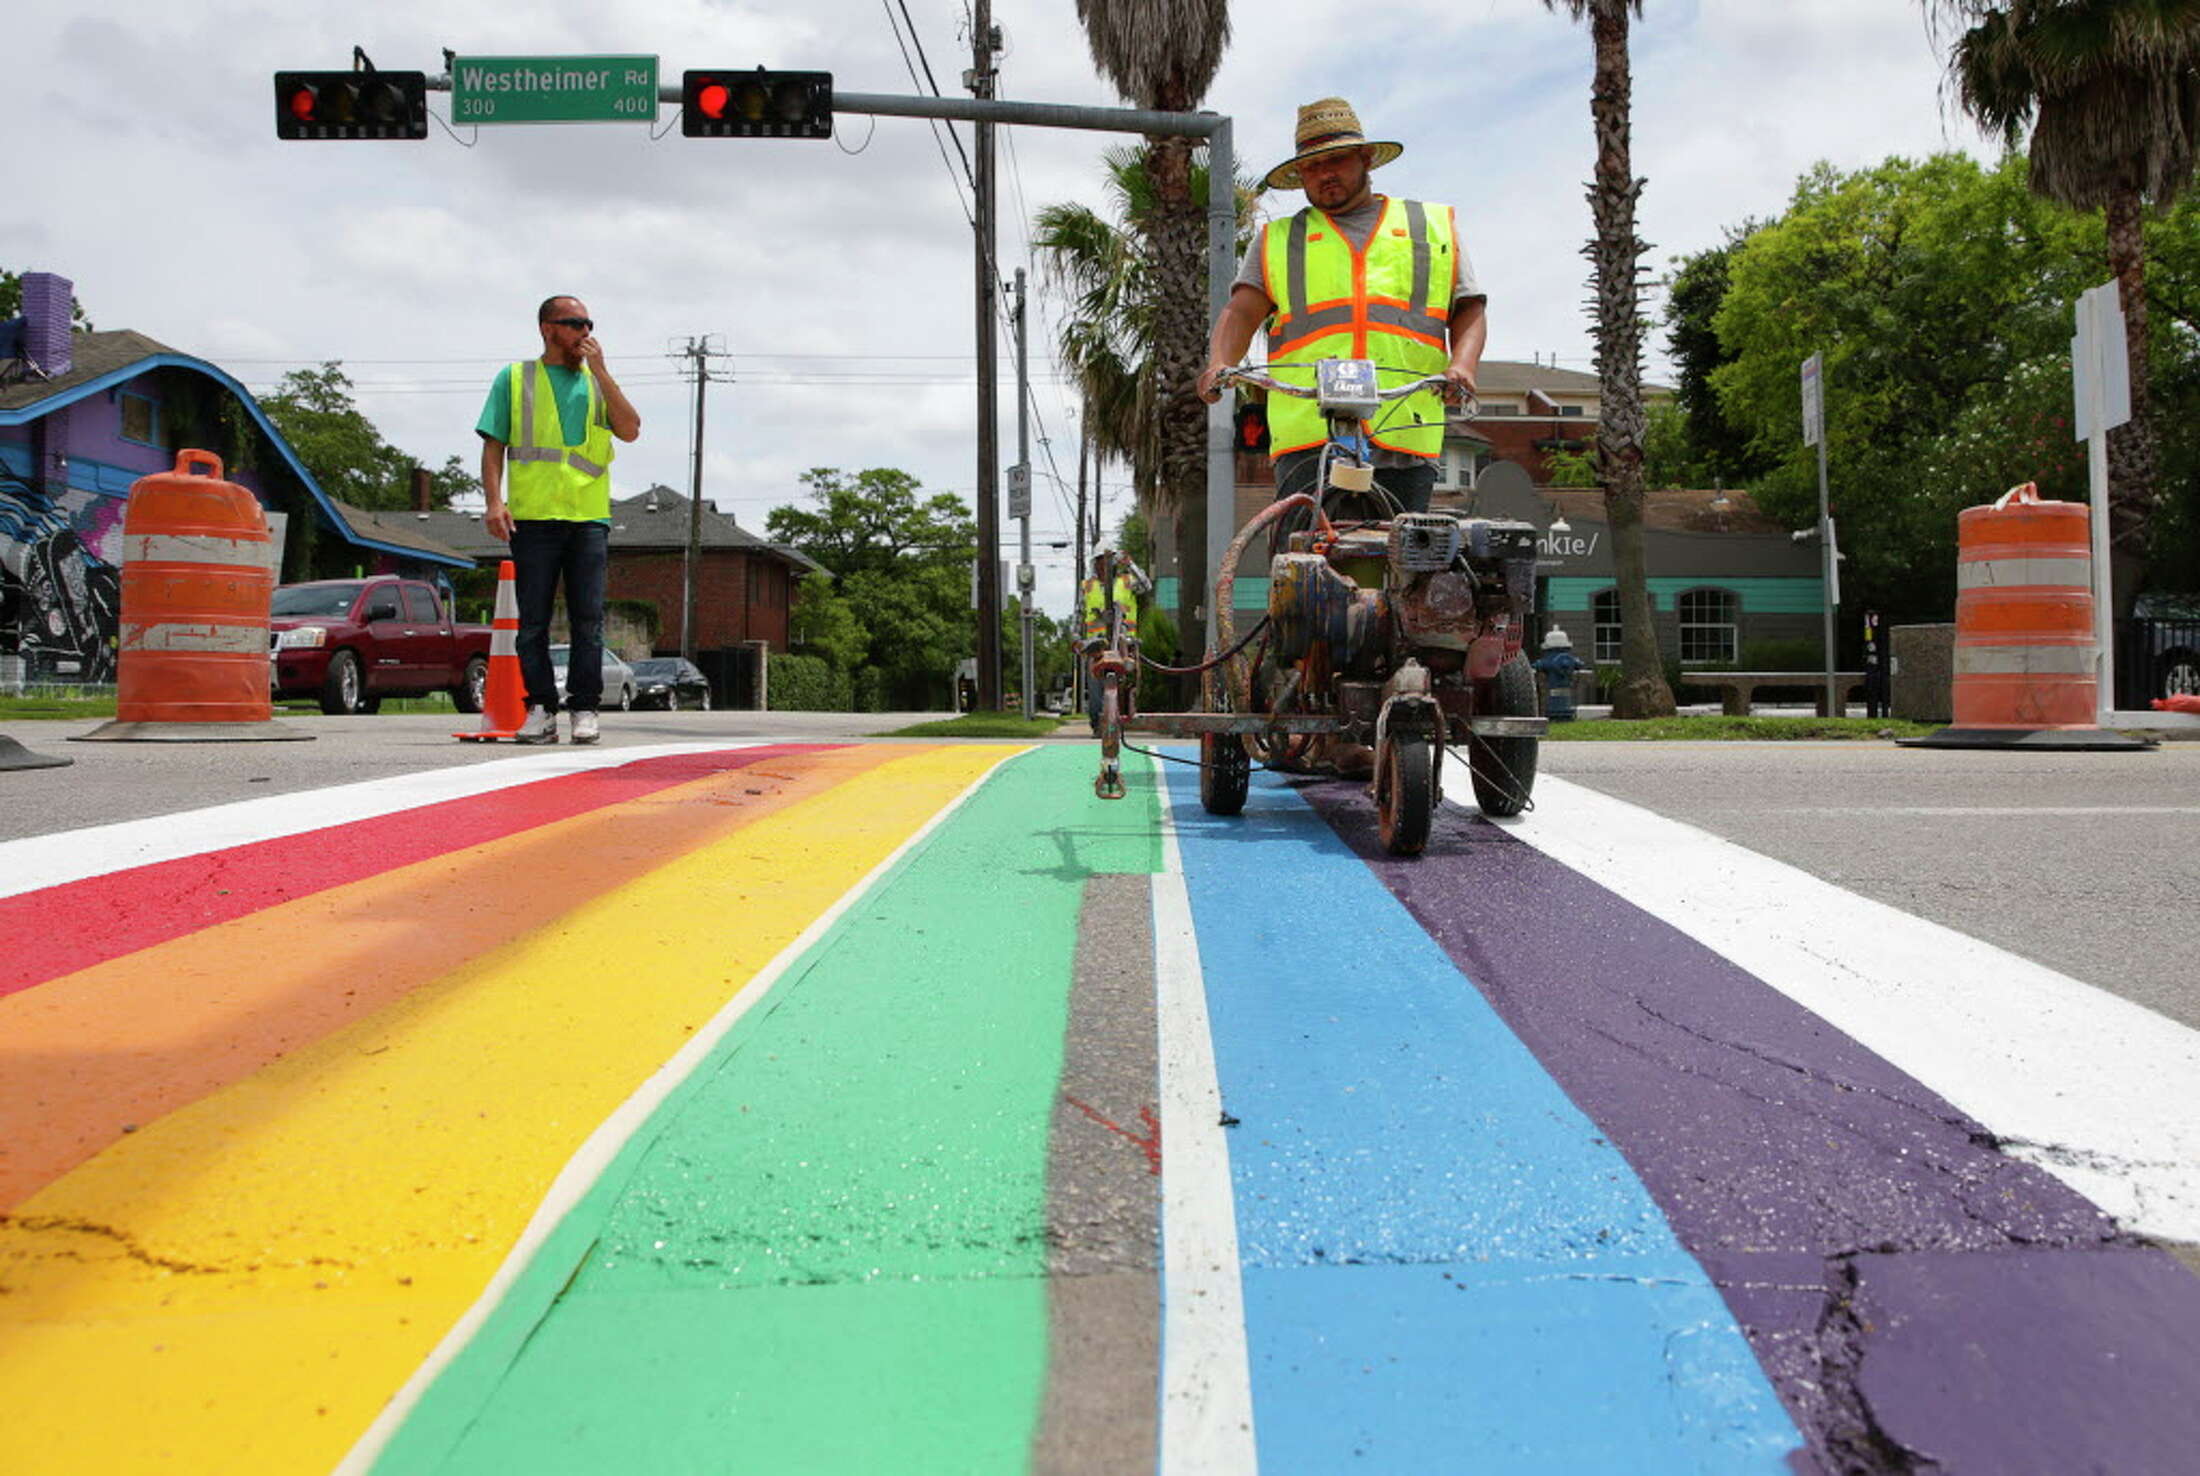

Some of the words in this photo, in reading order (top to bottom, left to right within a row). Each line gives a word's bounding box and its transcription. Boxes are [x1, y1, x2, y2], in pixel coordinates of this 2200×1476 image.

[462, 67, 610, 91] Westheimer
[624, 70, 648, 85] Rd
[463, 99, 495, 115] 300
[613, 98, 648, 113] 400
